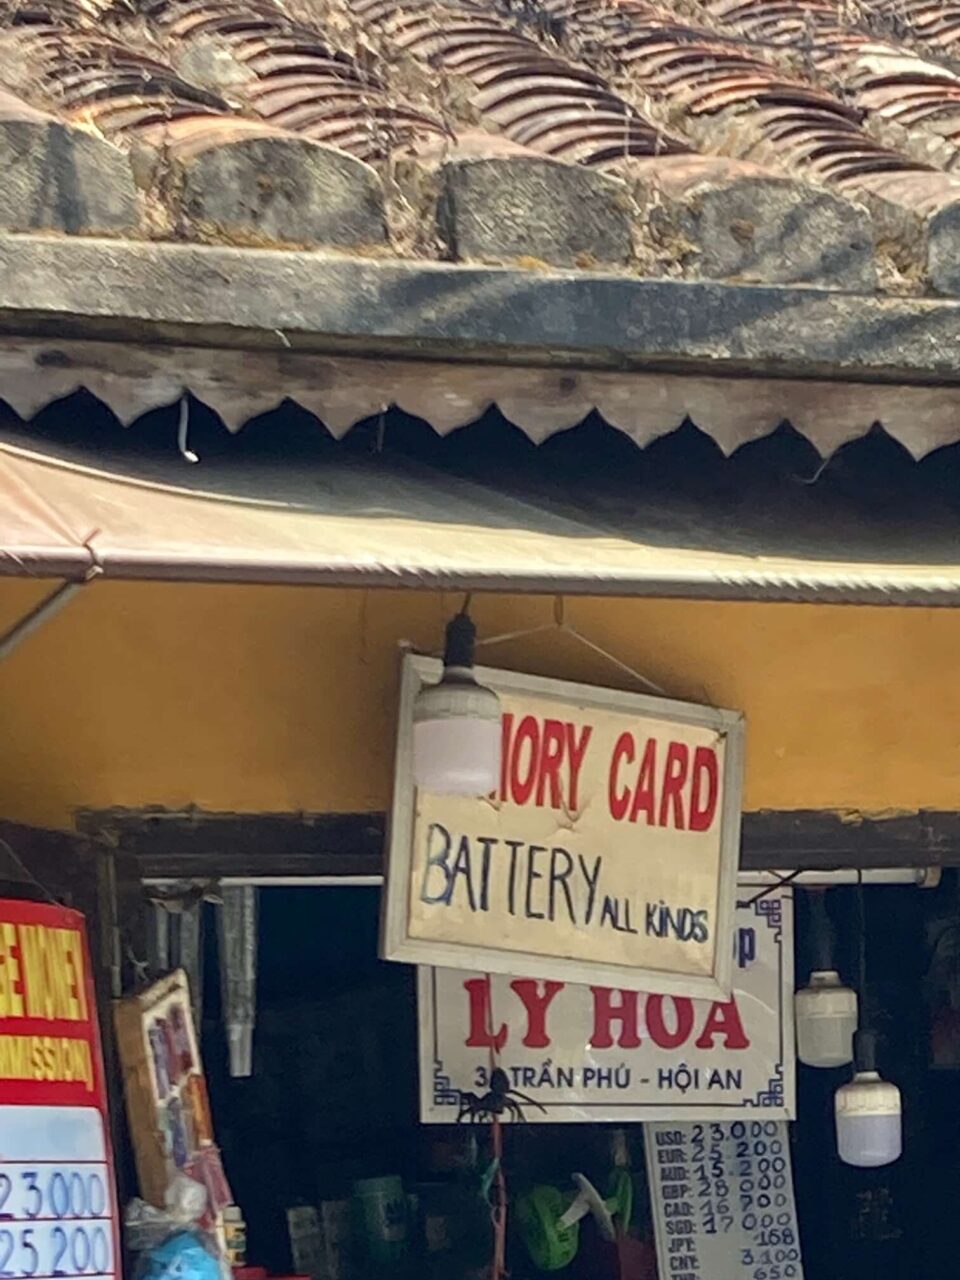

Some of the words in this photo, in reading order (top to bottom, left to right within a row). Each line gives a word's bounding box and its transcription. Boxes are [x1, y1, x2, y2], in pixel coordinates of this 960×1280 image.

[608, 732, 719, 833] CARD
[420, 823, 602, 925] BATTERY
[600, 895, 638, 934] ALL
[583, 1063, 631, 1089] PHÚ
[658, 1062, 699, 1093] HỘI
[707, 1067, 742, 1089] AN
